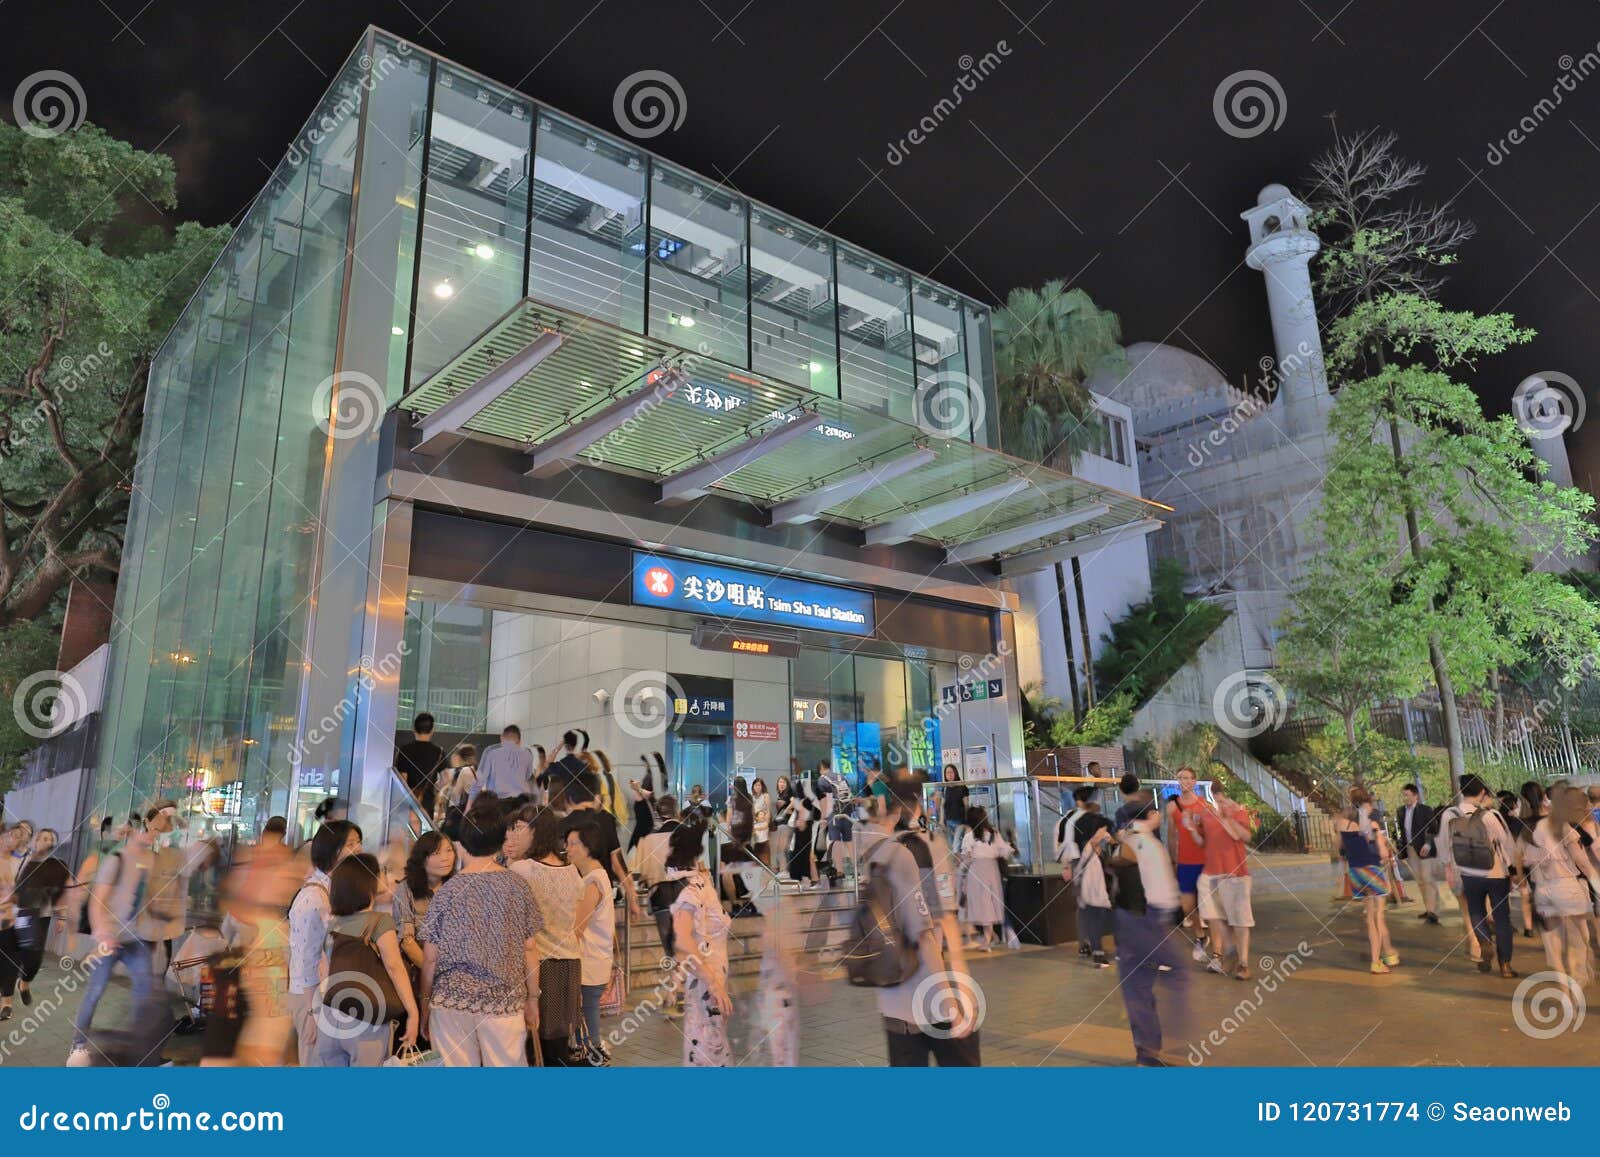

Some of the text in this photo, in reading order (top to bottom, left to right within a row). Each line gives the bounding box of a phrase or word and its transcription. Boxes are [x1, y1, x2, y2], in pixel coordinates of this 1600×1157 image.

[684, 576, 865, 624] 尖沙咀站 Tsim Sha Tsui Station
